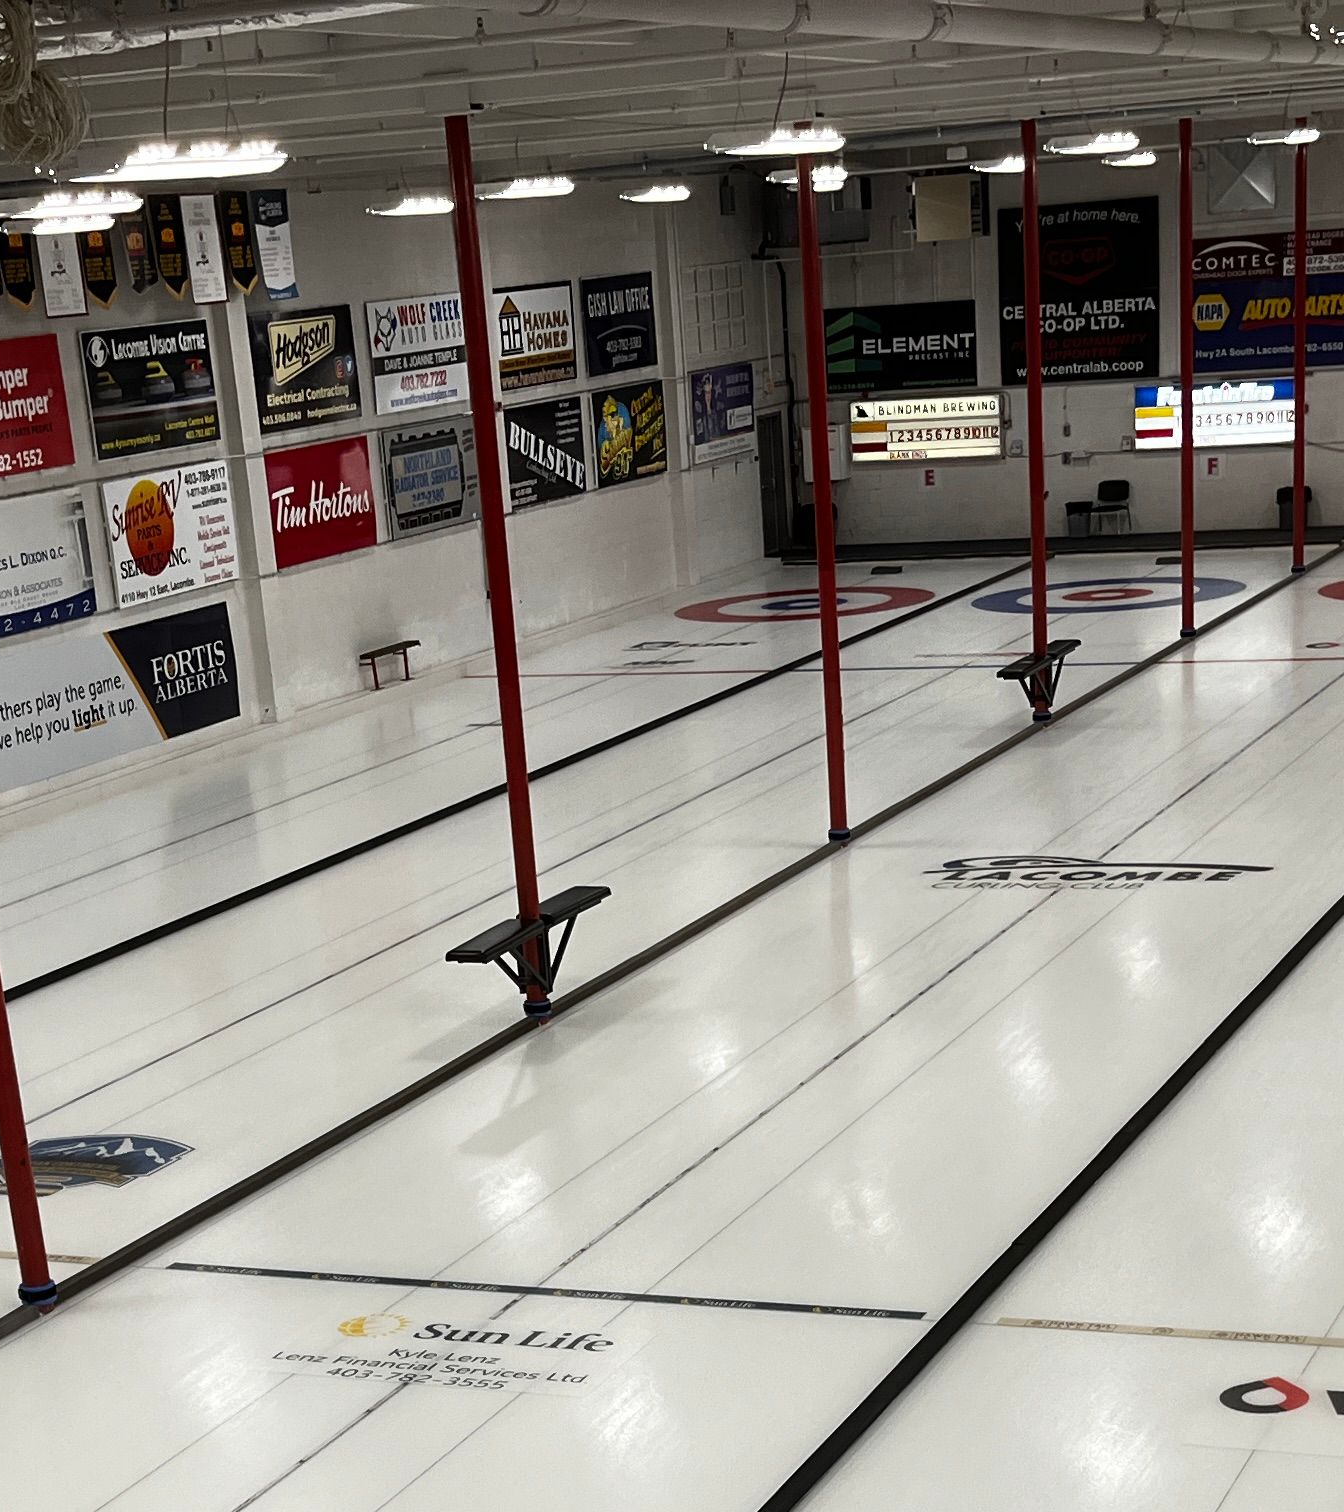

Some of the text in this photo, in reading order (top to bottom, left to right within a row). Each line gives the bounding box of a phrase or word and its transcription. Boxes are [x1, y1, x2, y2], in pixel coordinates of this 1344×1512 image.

[1057, 208, 1141, 224] at home here.
[1191, 253, 1276, 271] COMTEC
[397, 299, 460, 326] WOLF CREEK
[588, 286, 650, 318] GISH LAW OFFICE
[1003, 297, 1156, 320] CETRAL ALBERTA
[1197, 303, 1223, 321] NAPA
[522, 310, 569, 332] HAVANA
[111, 331, 206, 361] LACOMBE VISION CENTRE
[275, 321, 330, 369] Hodgson
[527, 331, 568, 352] HOMES
[862, 333, 974, 355] ELEMENT
[878, 400, 996, 416] BLINDMAN BREWING
[509, 421, 585, 490] BULLSEYE
[1206, 457, 1219, 477] F
[925, 470, 935, 486] E
[111, 470, 182, 543] Sunrise RV
[271, 479, 370, 533] Tim Hortons
[151, 640, 225, 685] FORTIS
[36, 690, 62, 713] play
[65, 685, 86, 703] the
[88, 673, 125, 700] game,
[155, 668, 229, 703] ALBERTA
[943, 870, 1240, 882] LACOMBE
[412, 1321, 615, 1355] Sun Life
[272, 1349, 325, 1366] Lenz
[328, 1354, 437, 1374] Financial
[444, 1362, 538, 1380] Services
[387, 1346, 501, 1367] Kyle Lenz
[326, 1366, 509, 1391] 403-782-3555
